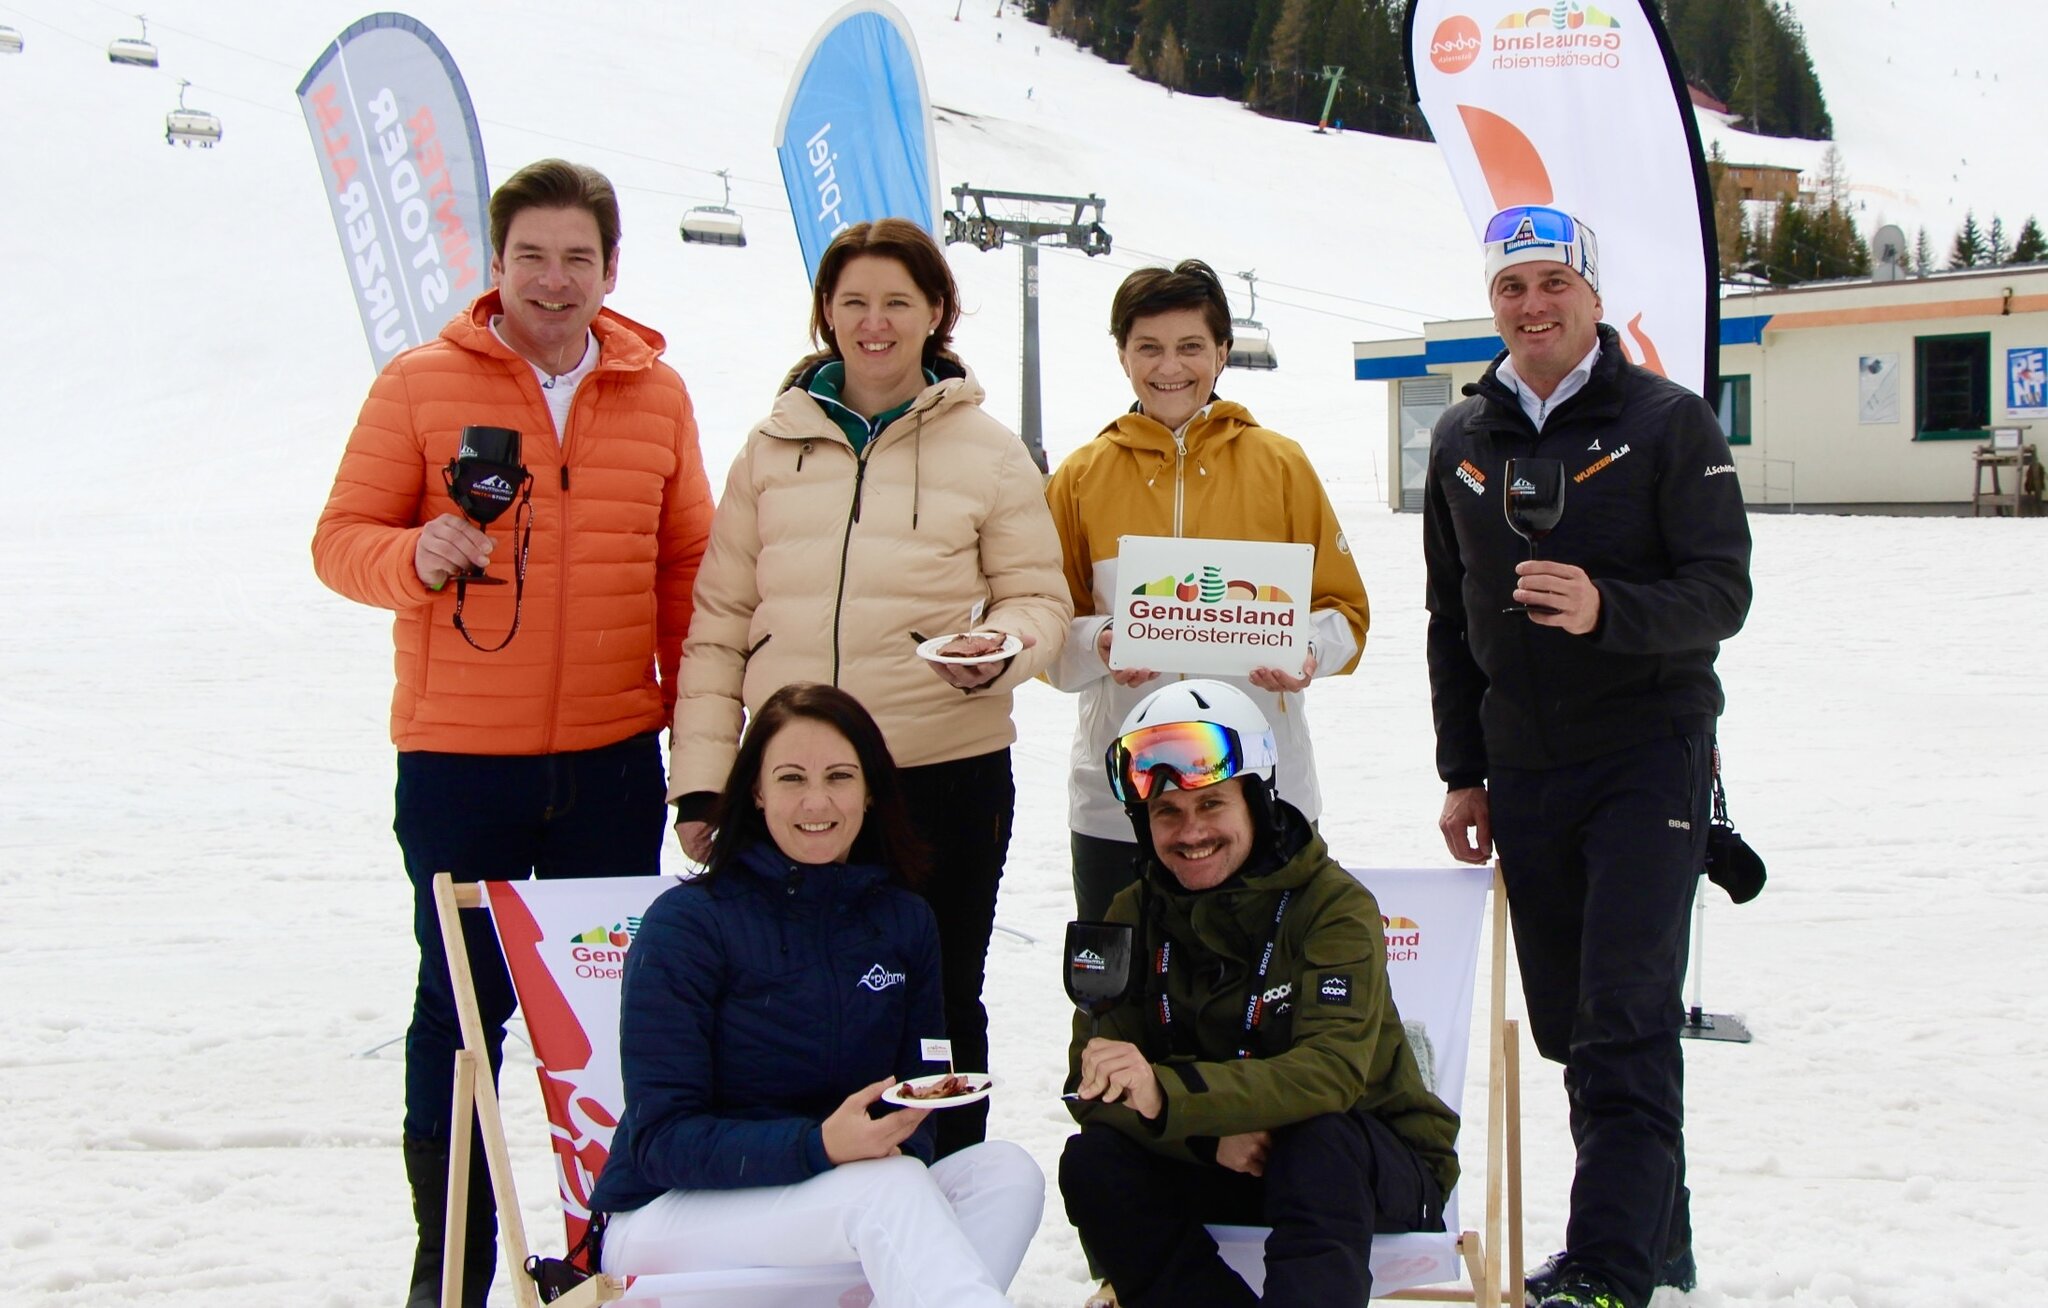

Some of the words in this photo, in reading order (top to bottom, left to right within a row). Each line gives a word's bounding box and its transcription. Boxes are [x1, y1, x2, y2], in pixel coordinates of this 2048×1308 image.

[1459, 459, 1486, 483] HINTER
[1573, 443, 1631, 484] WURZERALM
[1455, 466, 1486, 496] STODER
[1128, 601, 1295, 627] Genussland
[1127, 622, 1293, 647] Oberösterreich
[1258, 942, 1274, 976] STODER
[1322, 986, 1347, 996] dope
